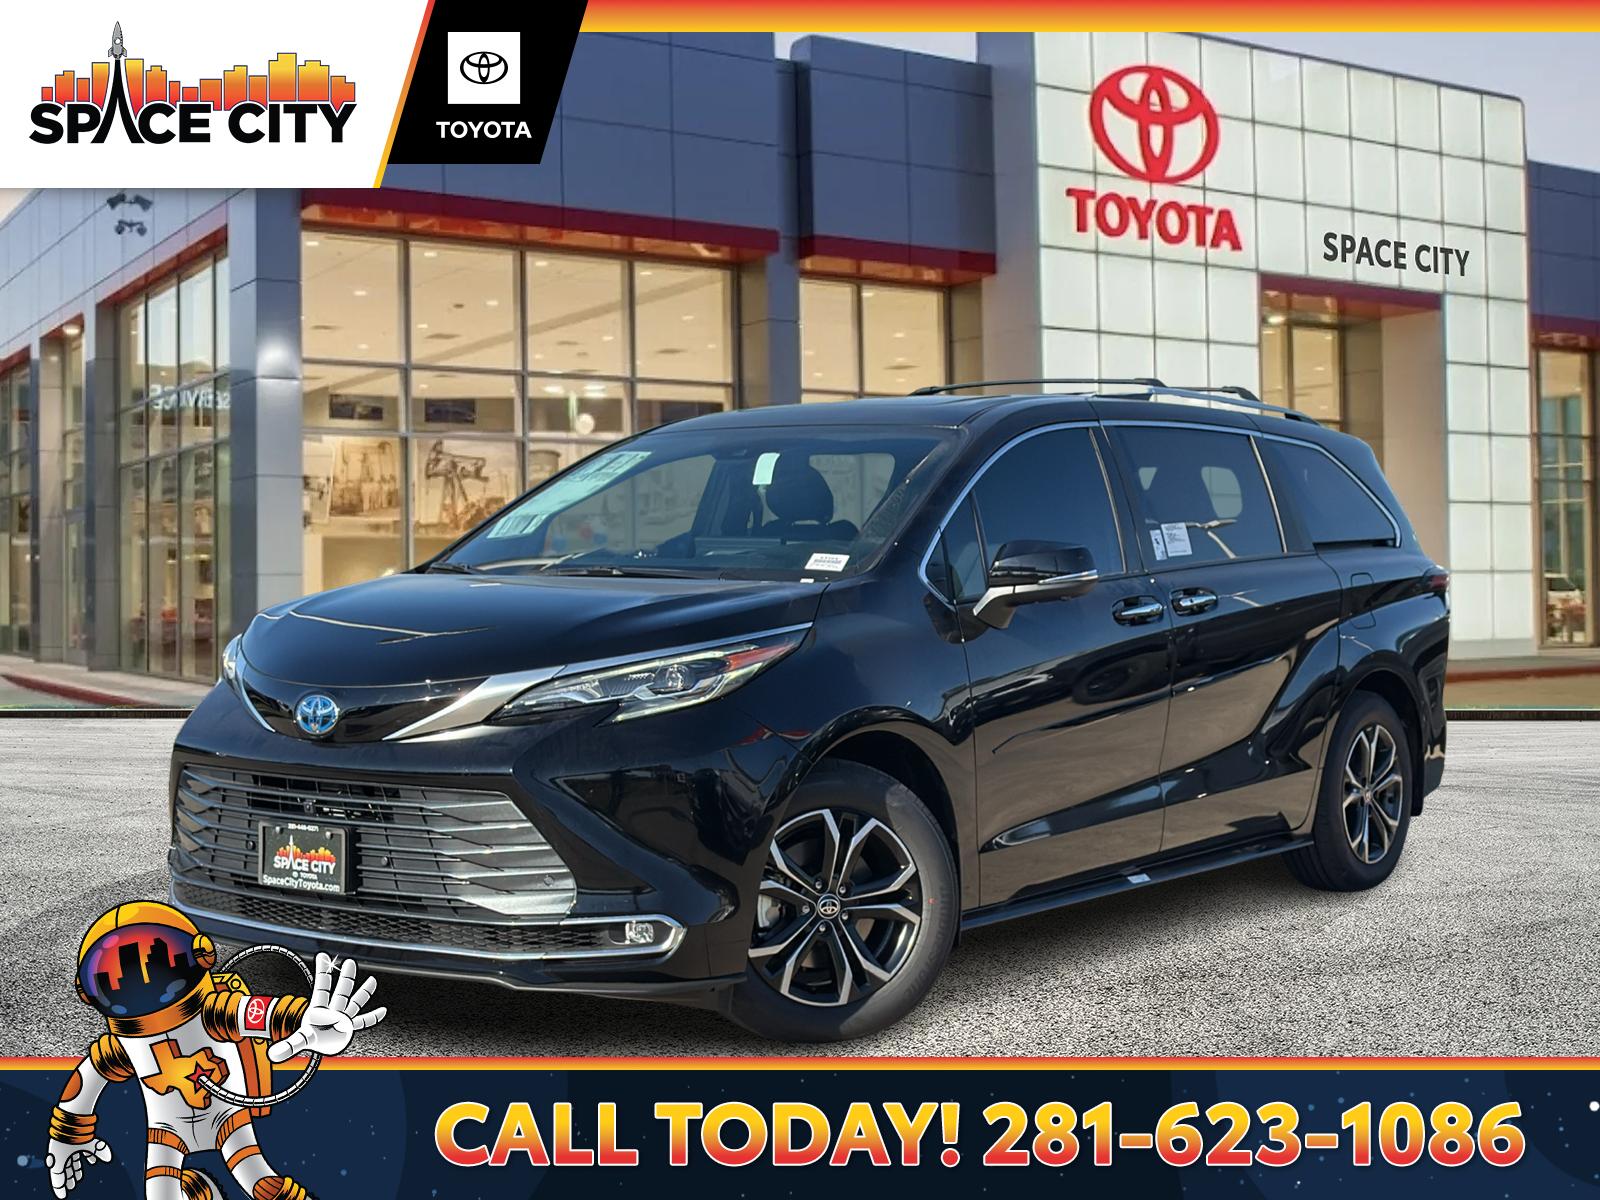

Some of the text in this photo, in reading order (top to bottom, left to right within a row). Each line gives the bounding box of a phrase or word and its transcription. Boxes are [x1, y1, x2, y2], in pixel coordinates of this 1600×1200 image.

[1066, 187, 1242, 251] TOYOTA
[1322, 231, 1471, 277] SPACE CITY
[273, 855, 336, 875] SPACE CITY
[263, 874, 340, 892] SpaceCityToyota.com
